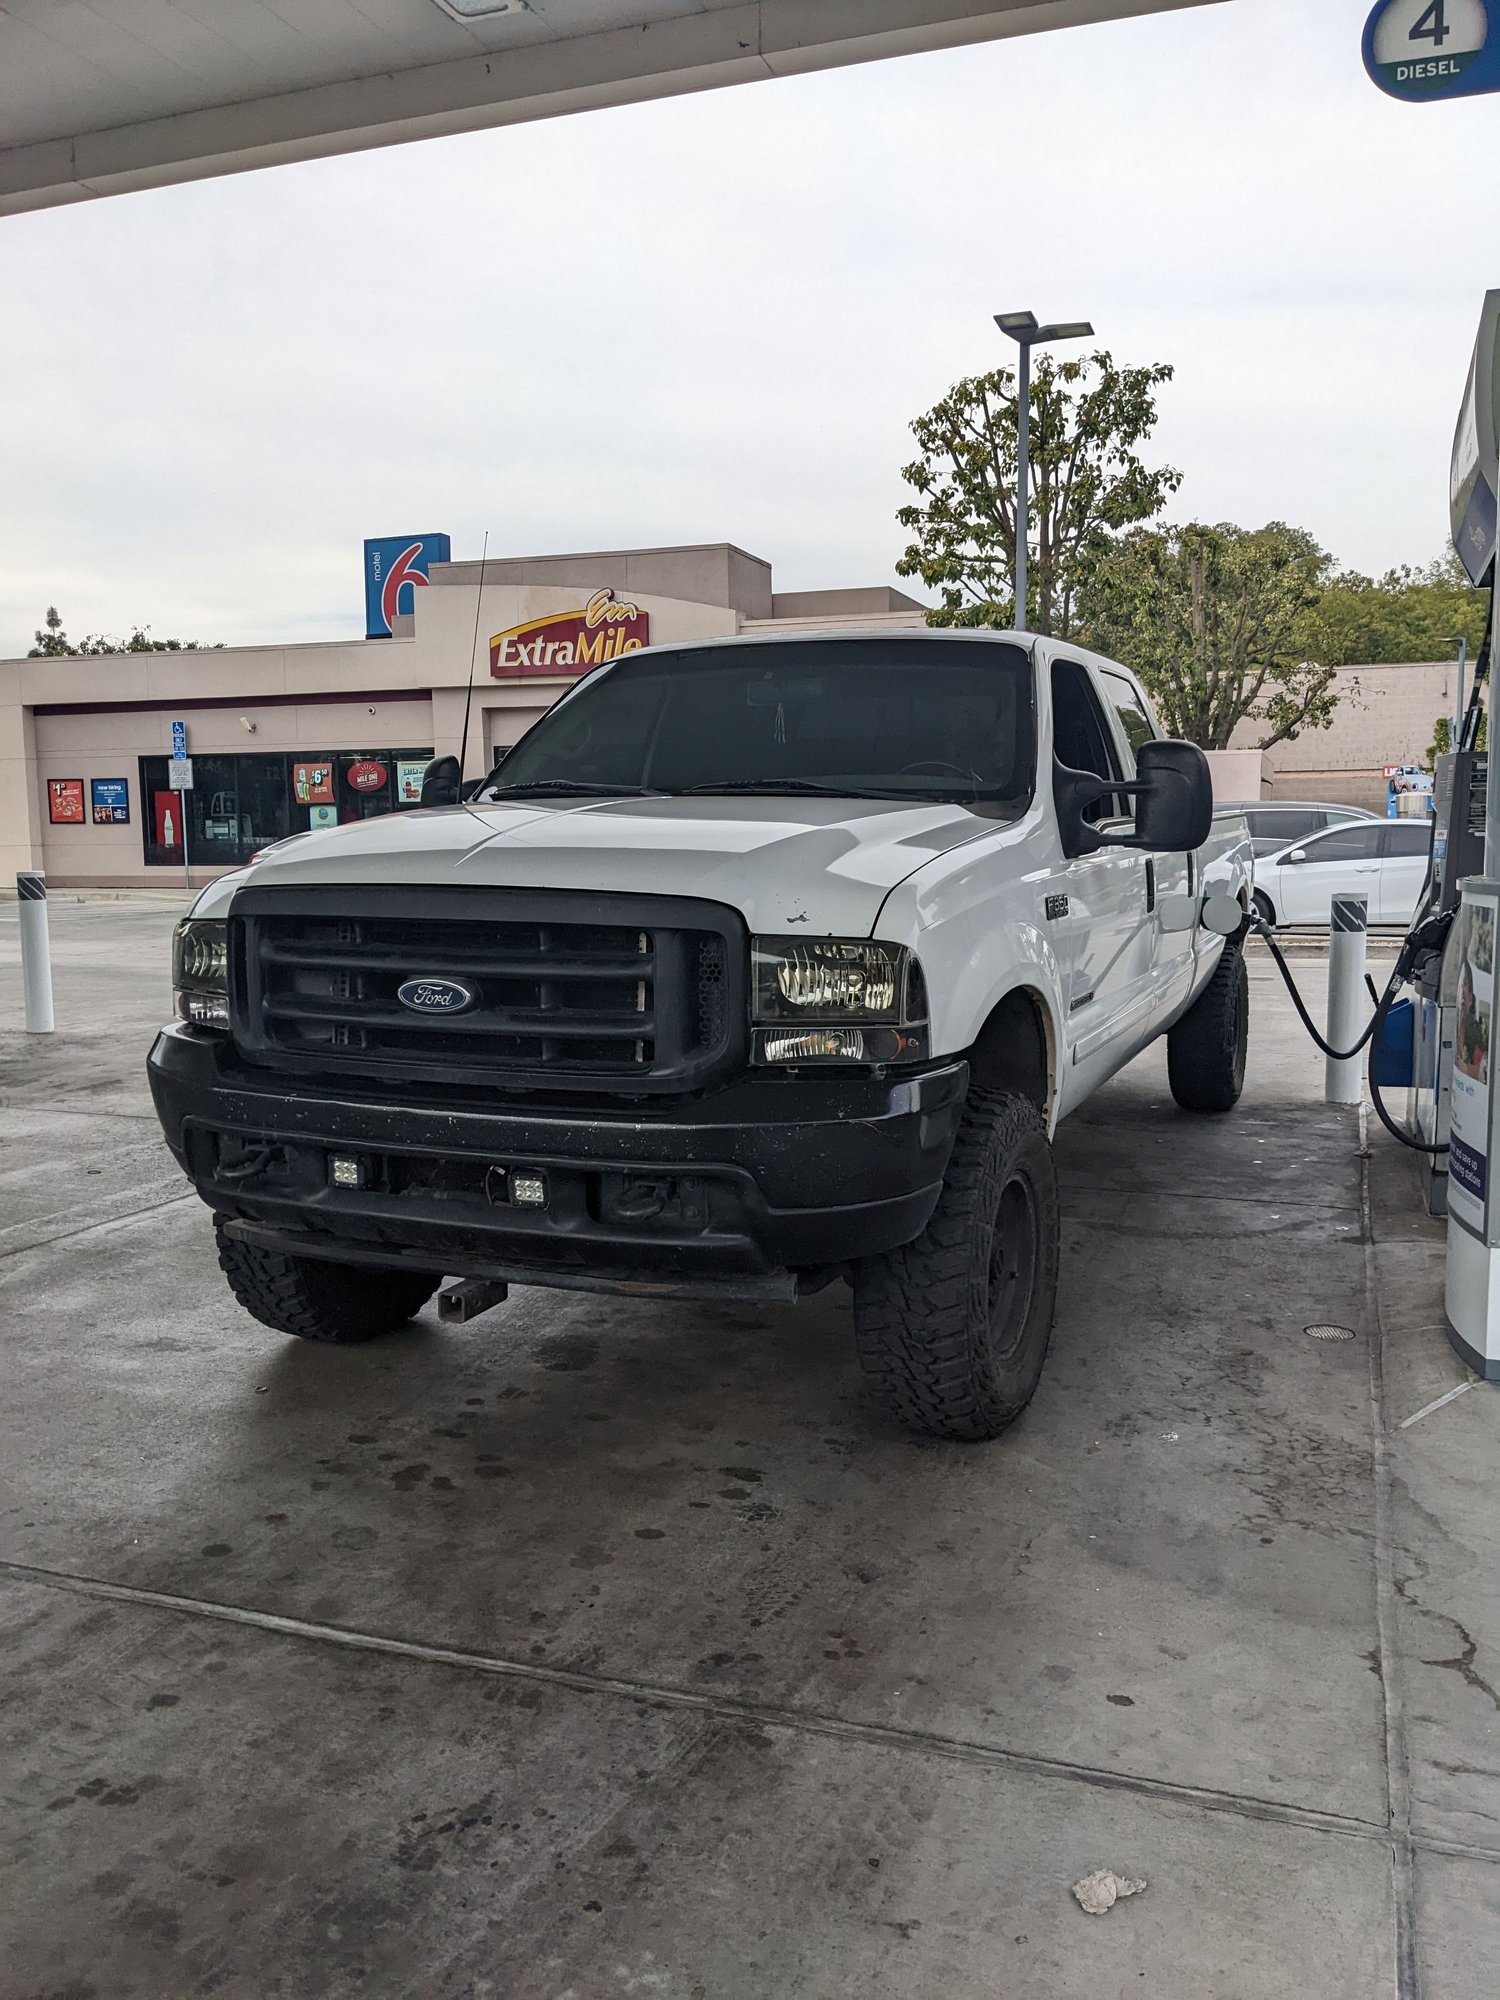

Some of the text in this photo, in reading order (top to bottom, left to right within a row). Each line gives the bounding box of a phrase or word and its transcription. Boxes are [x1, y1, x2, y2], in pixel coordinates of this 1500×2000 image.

[1408, 0, 1450, 47] 4
[1396, 59, 1461, 81] DIESEL
[372, 542, 430, 633] motel 6
[356, 772, 378, 783] MILE ONE
[414, 984, 453, 1006] Ford
